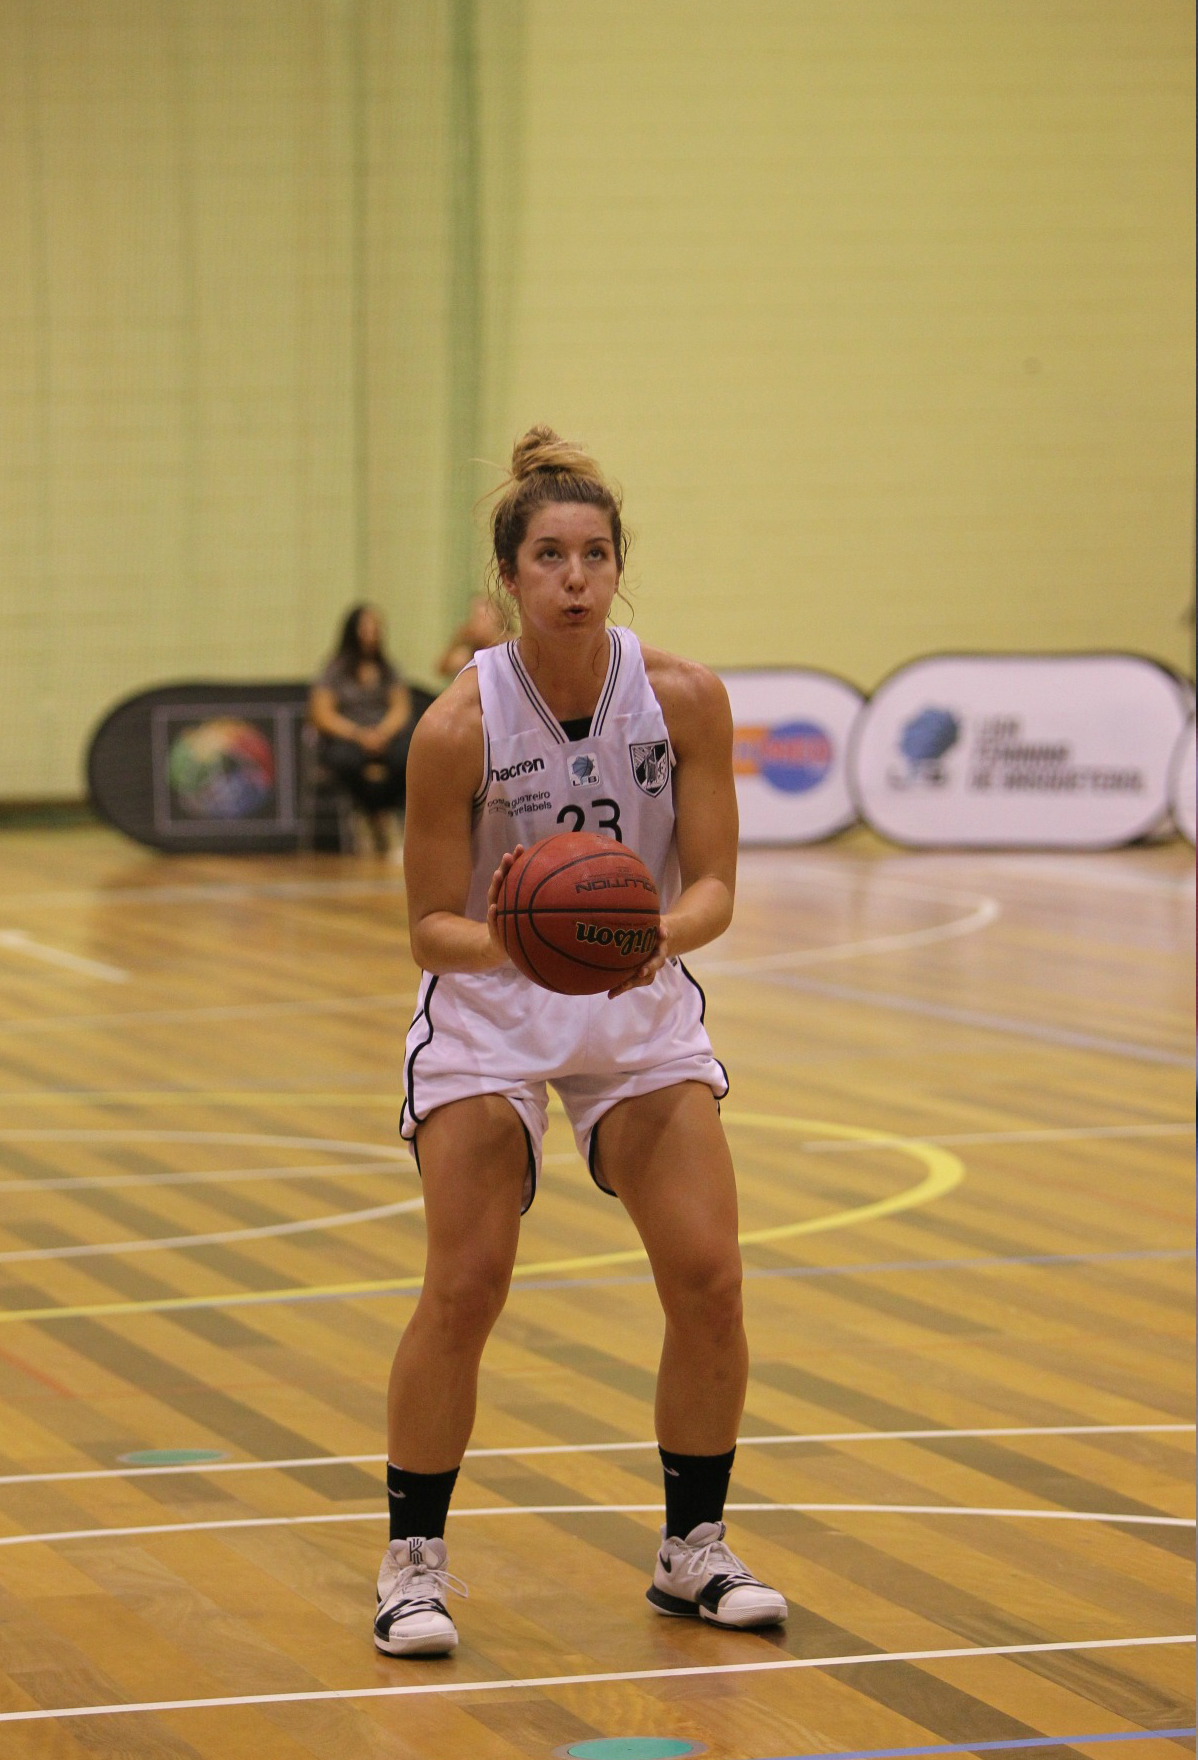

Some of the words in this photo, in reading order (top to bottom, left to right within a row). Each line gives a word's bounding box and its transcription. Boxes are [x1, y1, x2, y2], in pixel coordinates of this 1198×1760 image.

[556, 799, 623, 844] 23
[575, 877, 657, 894] OLUTION
[576, 921, 659, 957] Wilson
